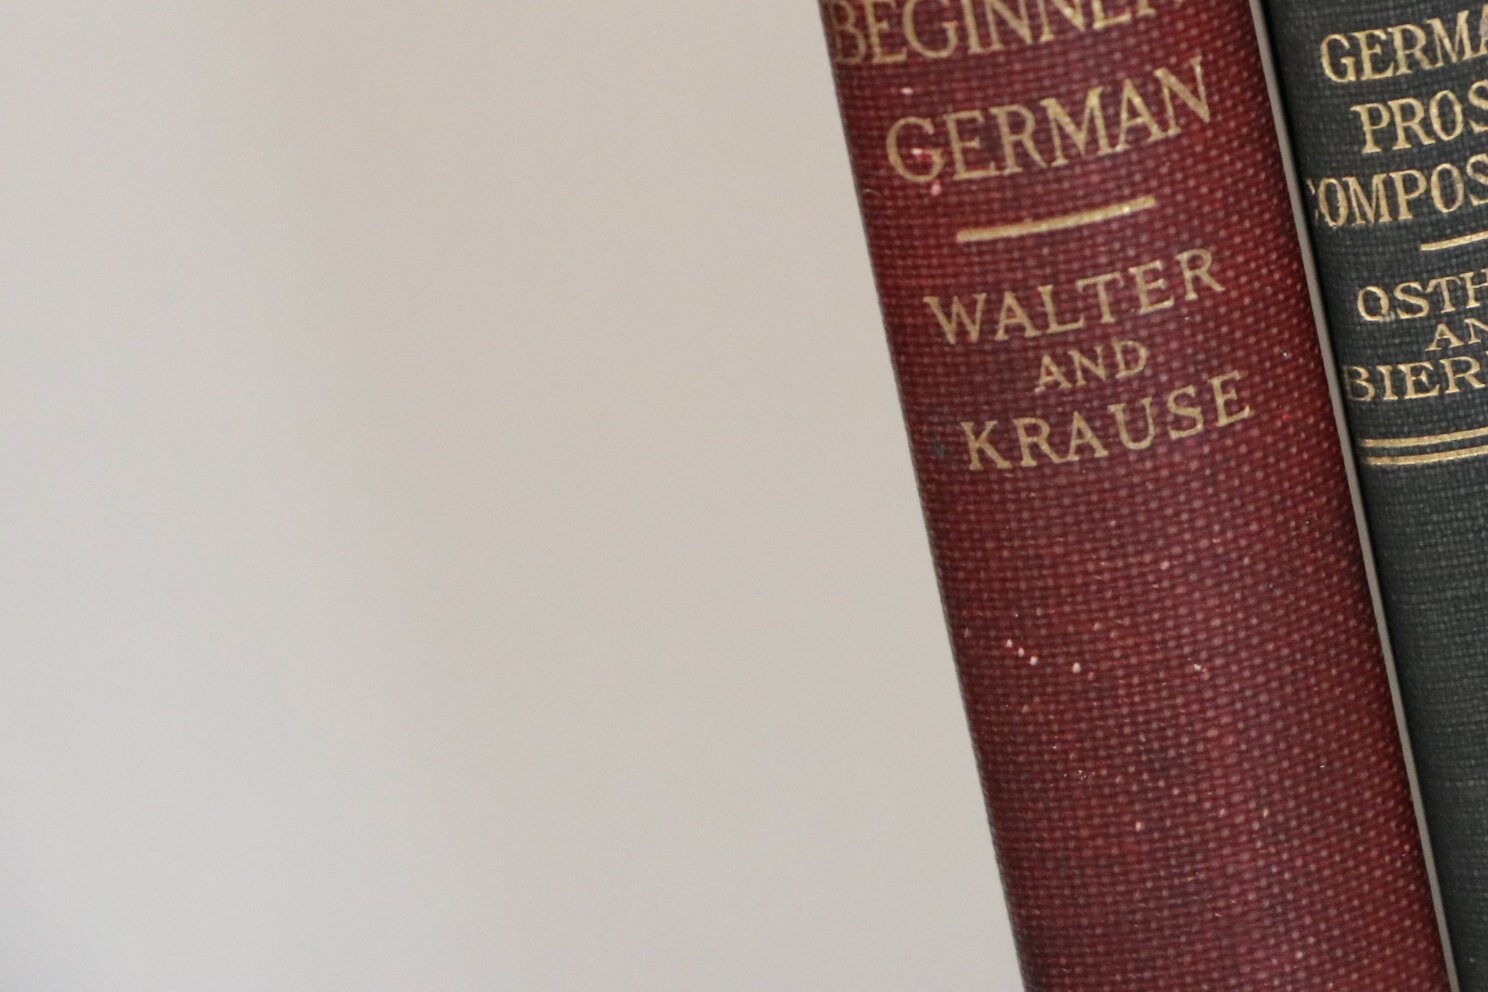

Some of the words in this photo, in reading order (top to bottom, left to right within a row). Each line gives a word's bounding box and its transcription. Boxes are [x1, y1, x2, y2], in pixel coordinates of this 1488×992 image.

[886, 56, 1211, 183] GERMAN
[923, 248, 1226, 345] WALTER
[1034, 336, 1150, 394] AND
[959, 370, 1251, 471] KRAUSE
